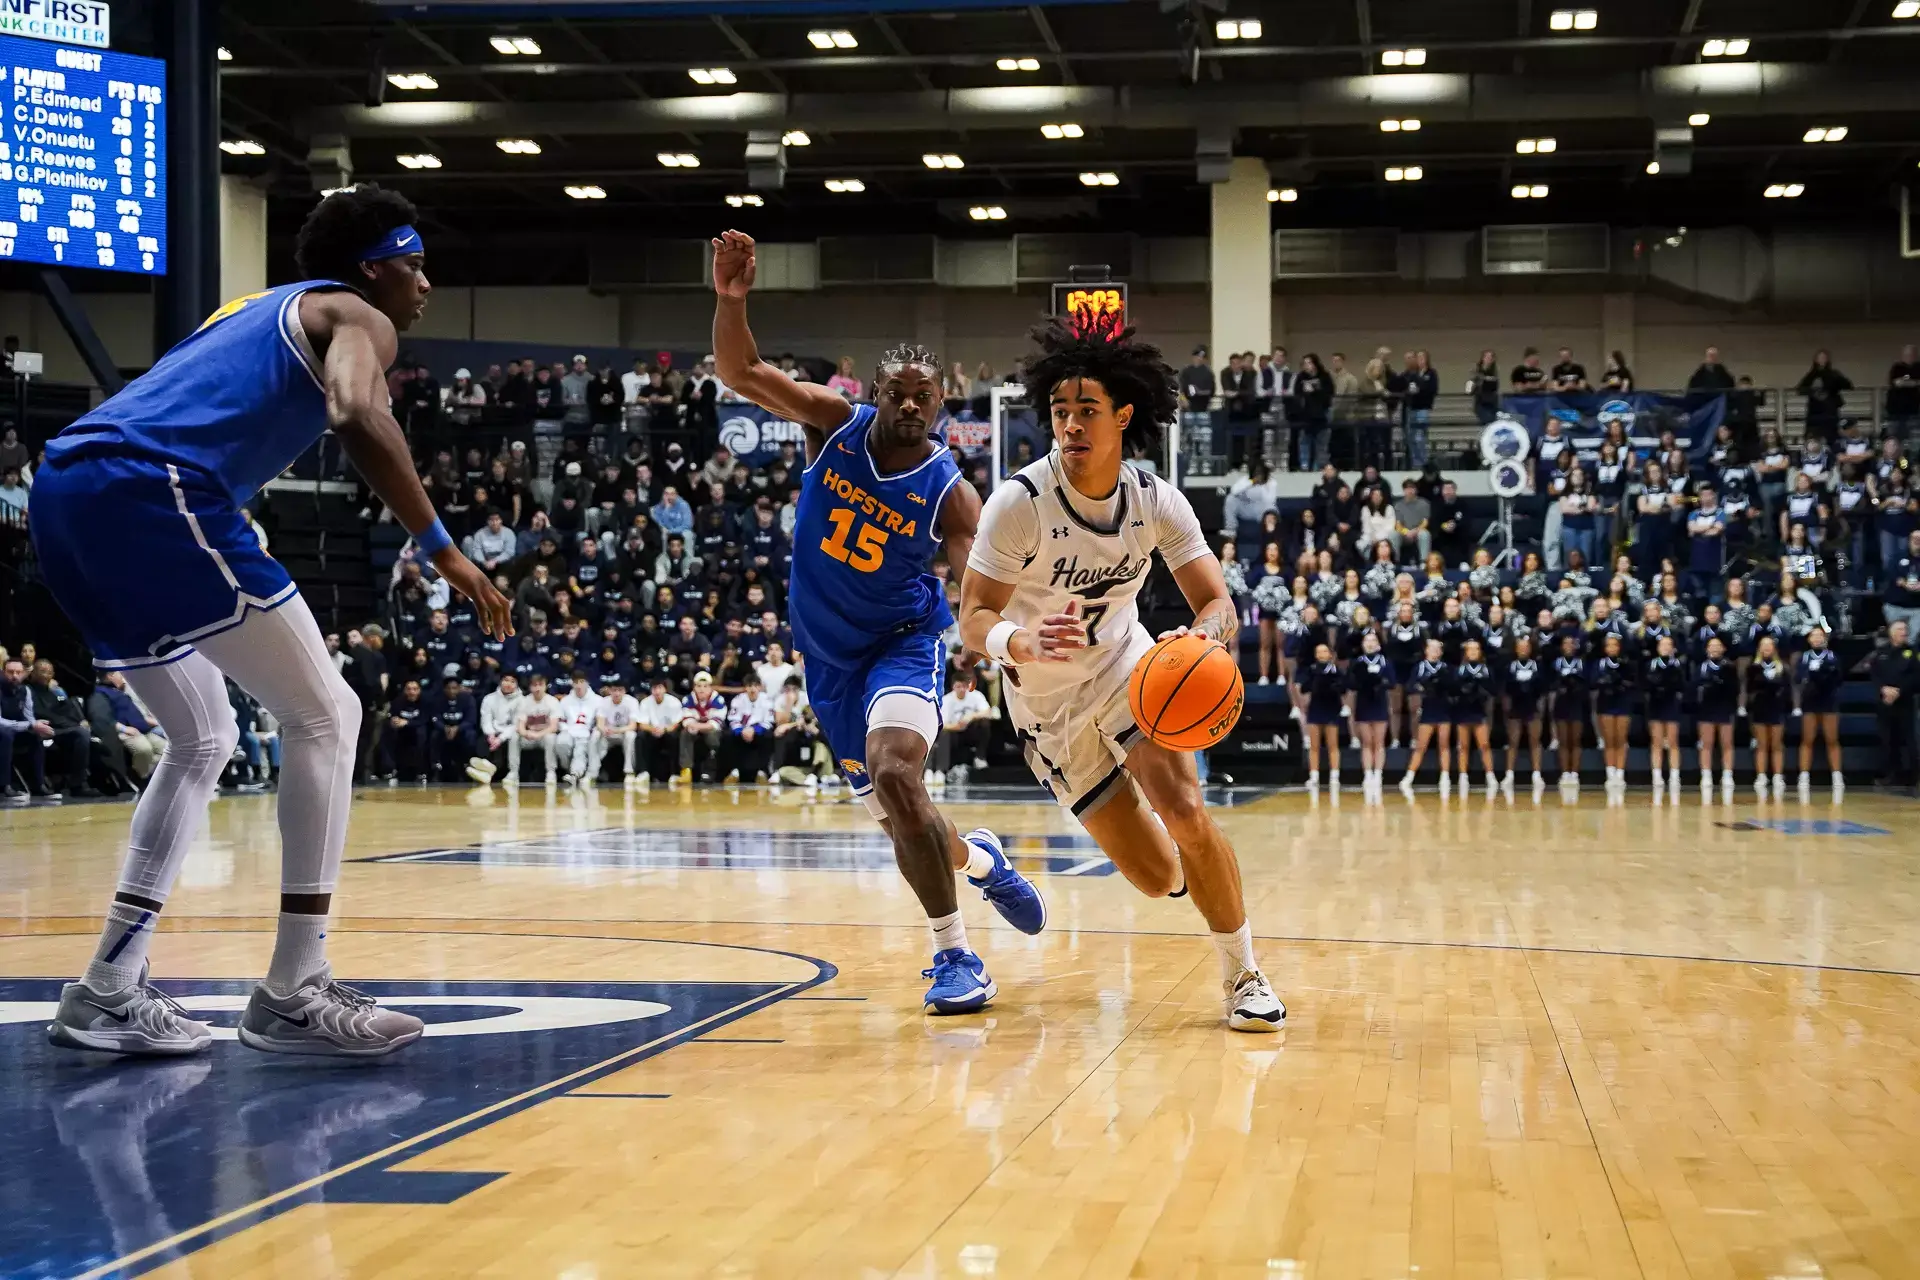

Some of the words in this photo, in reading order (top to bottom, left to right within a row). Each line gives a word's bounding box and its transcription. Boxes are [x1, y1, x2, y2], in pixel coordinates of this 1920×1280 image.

[29, 20, 105, 43] CENTER
[56, 48, 102, 72] GUEST
[108, 80, 136, 101] PTS
[14, 104, 84, 129] C.Davis
[144, 121, 156, 140] 2
[145, 102, 155, 120] 1
[14, 124, 95, 151] V.Onuetu
[144, 140, 156, 159] 2
[14, 144, 97, 171] J.Reaves
[14, 164, 109, 191] G.Plotnikov
[144, 179, 156, 198] 2
[54, 243, 63, 261] 1
[823, 467, 916, 537] HOFSTRA
[906, 492, 927, 506] CAA
[820, 508, 889, 573] 15
[1049, 552, 1147, 589] Hawks
[1081, 601, 1110, 647] 7
[1272, 733, 1289, 751] N
